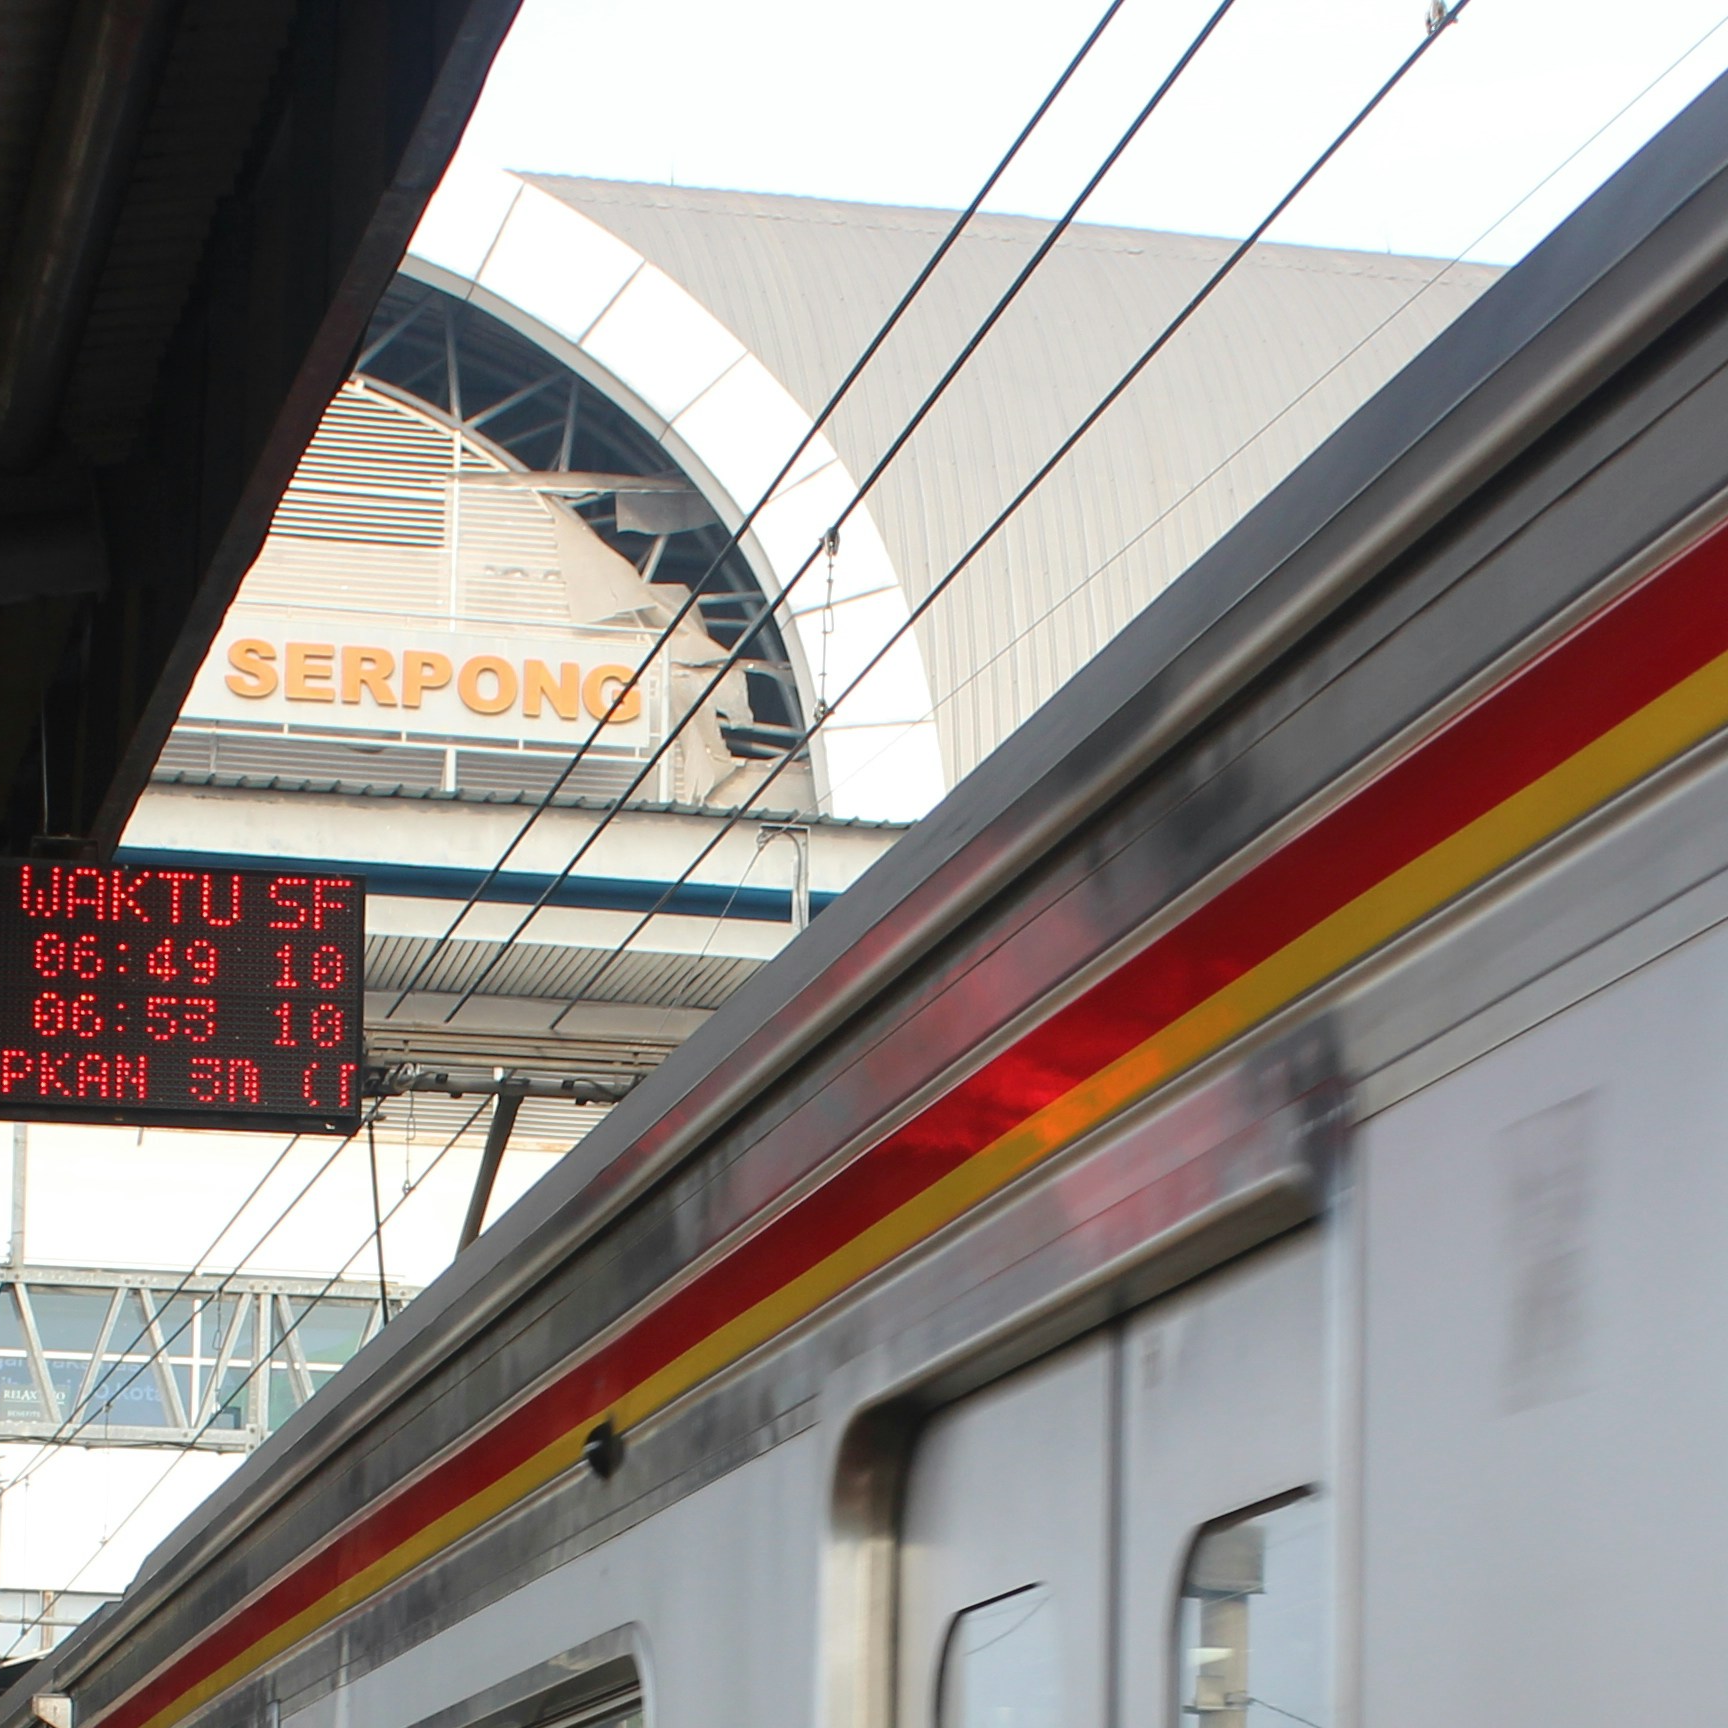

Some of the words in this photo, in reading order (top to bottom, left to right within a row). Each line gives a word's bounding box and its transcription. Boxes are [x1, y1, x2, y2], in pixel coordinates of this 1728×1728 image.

[224, 638, 642, 723] SERPONG
[21, 865, 241, 927] WAKTU
[34, 933, 218, 985] 06:49
[275, 944, 344, 990] 10
[33, 992, 217, 1043] 06:53
[274, 1002, 343, 1048] 10
